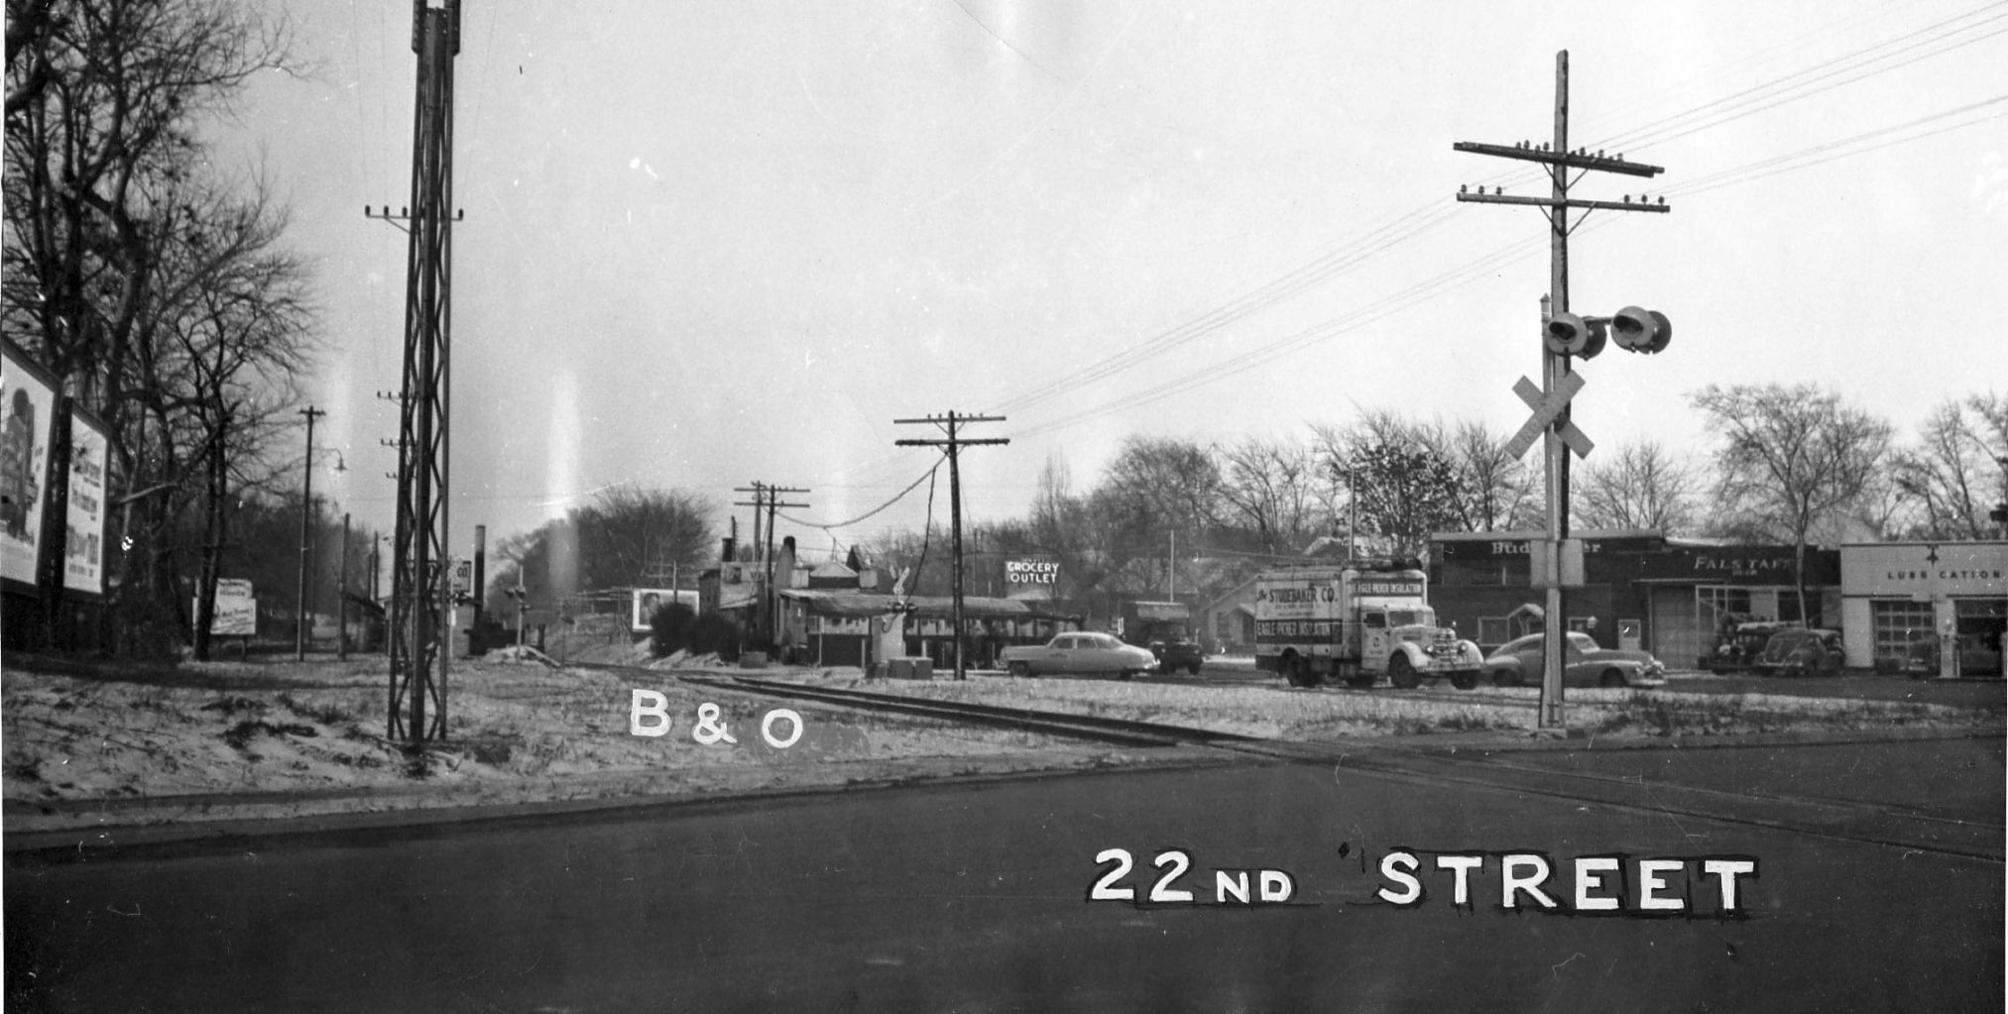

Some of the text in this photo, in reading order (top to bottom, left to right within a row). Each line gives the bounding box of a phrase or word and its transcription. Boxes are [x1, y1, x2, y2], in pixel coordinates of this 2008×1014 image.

[1007, 561, 1060, 573] GROCERY
[1009, 572, 1057, 584] OUTLET
[1269, 588, 1318, 603] STUDEBAKER
